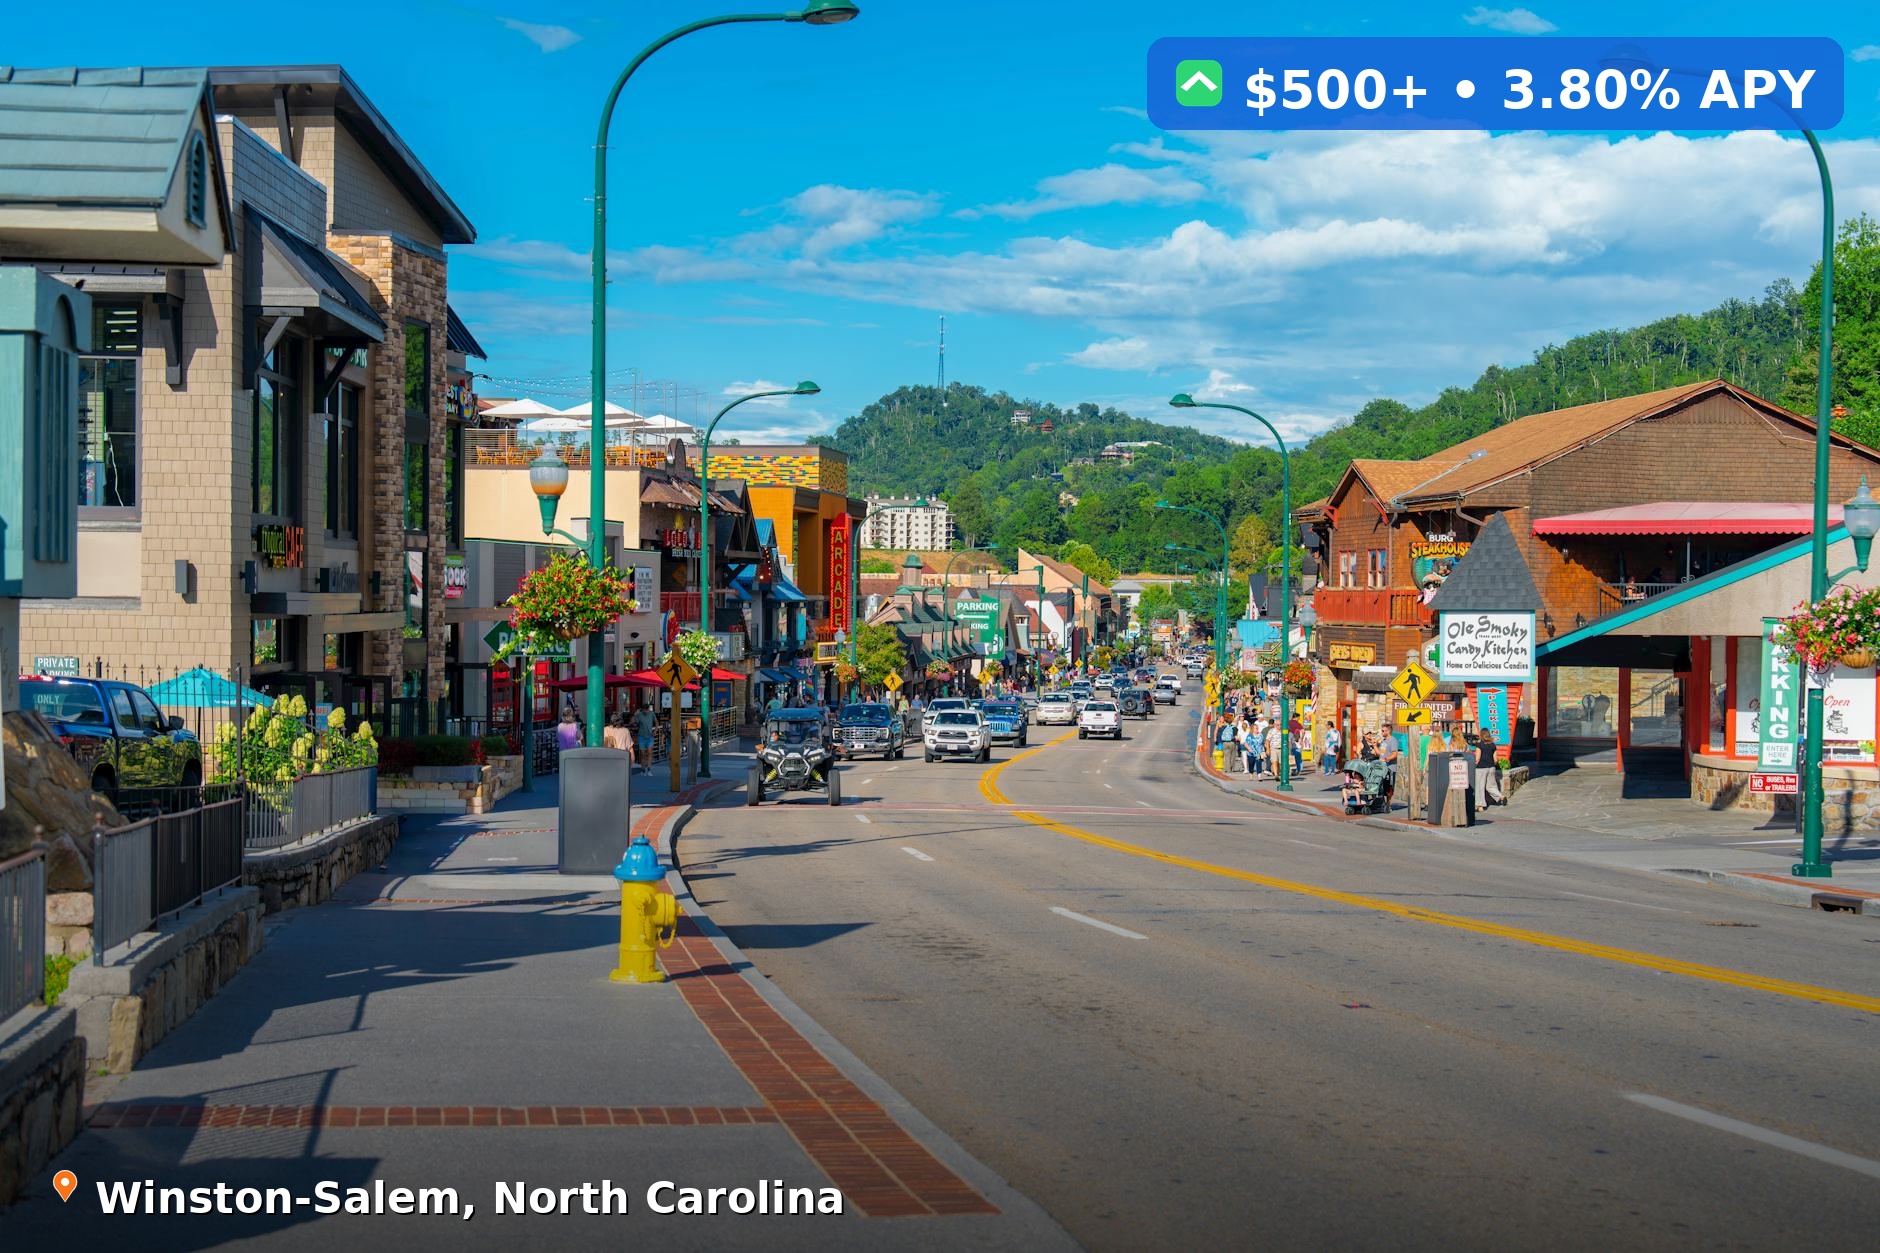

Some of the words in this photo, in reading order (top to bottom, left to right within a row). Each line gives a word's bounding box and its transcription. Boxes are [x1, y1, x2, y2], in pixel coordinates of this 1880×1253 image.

[1428, 534, 1454, 543] BURG
[285, 526, 305, 569] CAFE
[834, 530, 843, 628] ARCADE
[956, 602, 999, 611] PARKING
[1447, 621, 1474, 640] Ole
[1475, 615, 1528, 645] Smoky
[1447, 641, 1481, 662] Candy
[1481, 639, 1527, 662] Kitchen
[37, 657, 75, 668] PRIVATE
[1446, 660, 1463, 669] Home
[1472, 660, 1502, 670] Delicious
[1503, 661, 1529, 670] Candies
[37, 694, 60, 705] ONLY
[1824, 695, 1851, 708] Open
[1419, 702, 1453, 711] UNITED
[1765, 744, 1789, 752] ENTER
[1768, 751, 1788, 759] HERE
[1752, 779, 1764, 789] NO
[1771, 783, 1797, 792] TRAILERS
